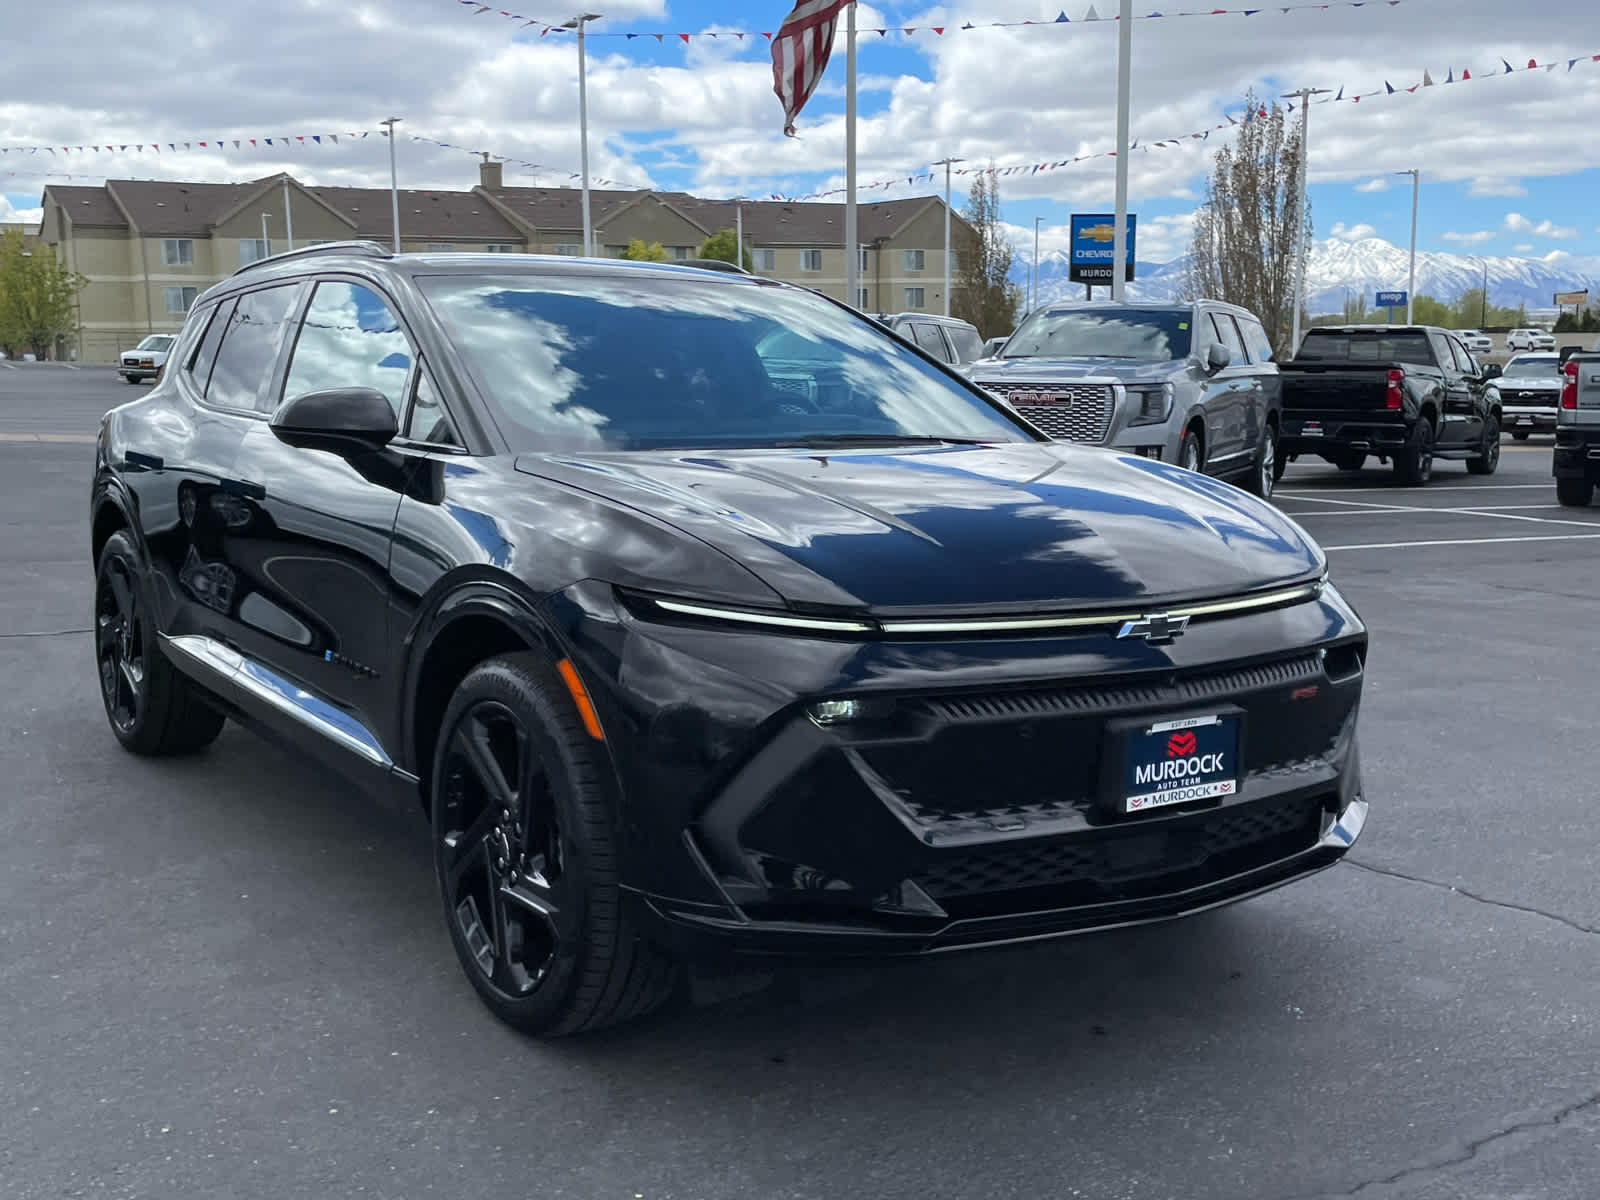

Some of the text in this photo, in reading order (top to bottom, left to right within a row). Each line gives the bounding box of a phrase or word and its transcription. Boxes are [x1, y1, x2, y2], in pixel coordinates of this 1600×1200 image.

[1076, 249, 1130, 258] CHEVRO
[1080, 269, 1112, 277] MURDO
[1010, 392, 1070, 406] GMC
[1135, 752, 1224, 785] MURDOCK
[1157, 776, 1201, 791] AUTO TEAM
[1152, 785, 1211, 805] MURDOCK
